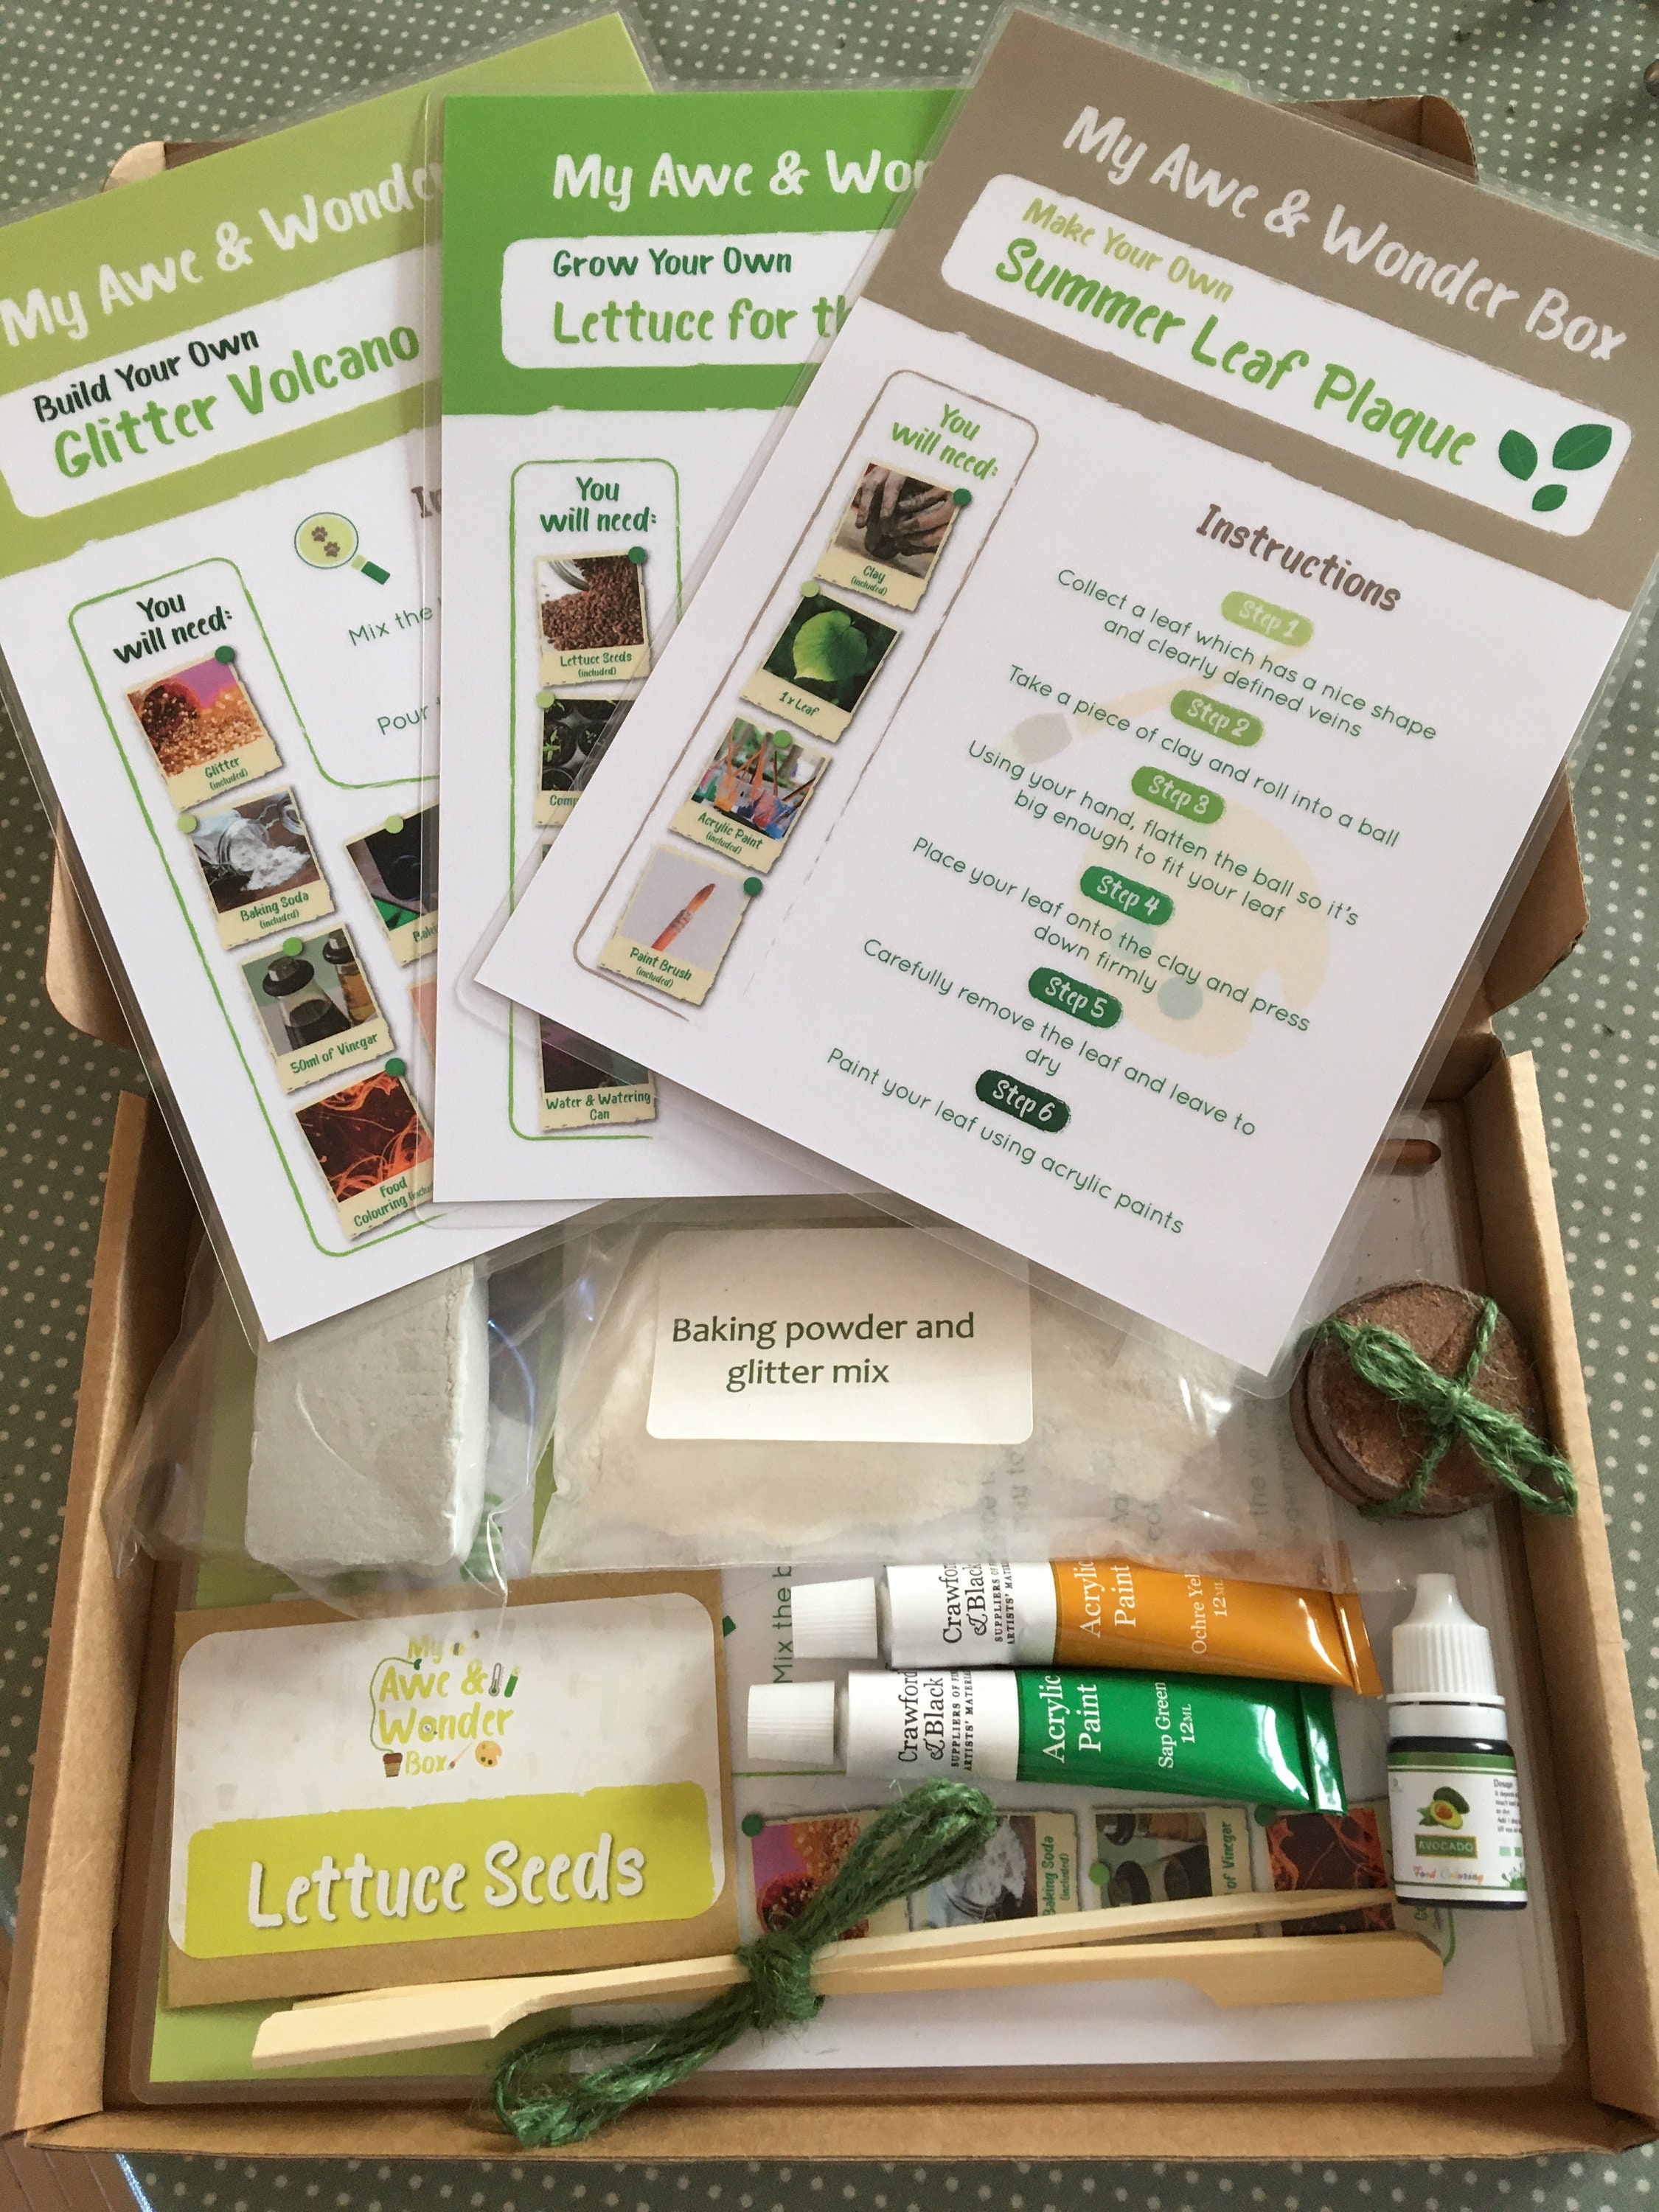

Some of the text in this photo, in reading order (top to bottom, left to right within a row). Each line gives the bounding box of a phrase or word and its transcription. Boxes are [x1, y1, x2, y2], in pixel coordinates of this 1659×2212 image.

[553, 150, 810, 212] My Awe &
[1023, 198, 1234, 303] Make Your Own
[1062, 105, 1629, 362] My Awe & Wonder Box
[552, 246, 791, 276] Grow Your Own
[1, 221, 254, 347] My Awe &
[553, 297, 799, 344] Lettuce for
[995, 237, 1478, 467] Summer Leaf Plaque
[32, 330, 260, 423] Build Your Own
[55, 325, 421, 479] Glitter Volcano
[939, 403, 981, 441] You
[891, 422, 999, 480] will need:
[576, 476, 620, 501] You
[540, 507, 657, 532] will need:
[863, 565, 886, 584] Clay
[1195, 503, 1402, 614] Instructions
[137, 594, 187, 624] You
[348, 606, 433, 647] Mix the
[1238, 599, 1298, 639] Step 1
[113, 606, 234, 664] will need:
[1058, 568, 1438, 741] Collect leaf which has nice shape
[560, 651, 633, 667] Lettuce Seeds
[578, 667, 617, 678] (included)
[1105, 619, 1362, 738] and clearly defined veins
[377, 705, 428, 736] Pour
[795, 698, 820, 716] Leaf
[1186, 699, 1251, 737] Step 2
[205, 757, 241, 779] Glitter
[1008, 664, 1401, 848] Take piece of clay and roll into ball
[1147, 775, 1211, 815] Step 3
[698, 812, 763, 850] Acrylic Paint
[969, 740, 1360, 926] Using your hand, flatten the ball so it's
[1015, 790, 1287, 922] big enough to fit your leaf
[240, 890, 310, 922] Baking Soda
[1096, 875, 1161, 915] Step 4
[913, 837, 1310, 1032] Place your leaf onto the clay and press
[630, 947, 692, 981] Paint Brush
[1034, 924, 1158, 993] down firmly
[1044, 976, 1109, 1018] Step 5
[290, 1032, 379, 1074] 50ml of Vinegar
[863, 939, 1256, 1136] Carefully remove the leaf and leave to
[1026, 1047, 1062, 1076] dry
[546, 1090, 651, 1110] Water & Watering
[589, 1107, 611, 1121] Can
[992, 1079, 1056, 1122] Step 6
[827, 1047, 1183, 1234] Paint your leaf using acrylic paints
[380, 1176, 408, 1197] Food
[353, 1194, 408, 1228] Colouring
[672, 1312, 975, 1351] Baking powder and
[726, 1357, 888, 1394] glitter mix
[992, 1579, 1003, 1642] SUPPLIERS
[1110, 1565, 1136, 1627] Paint
[408, 1634, 443, 1663] My
[1190, 1601, 1207, 1654] Ochre
[378, 1663, 487, 1702] Awe &
[773, 1641, 793, 1683] Mix
[378, 1703, 515, 1745] Wonder
[951, 1703, 960, 1767] SUPPLIERS
[1040, 1674, 1102, 1764] Acrylic Paint
[1155, 1682, 1175, 1769] Sap Green
[405, 1750, 448, 1775] Box
[1041, 1835, 1054, 1869] Soda
[1222, 1821, 1237, 1889] of Vinegar
[1419, 1840, 1473, 1853] AVOCADO
[248, 1832, 646, 1929] Lettuce Seeds
